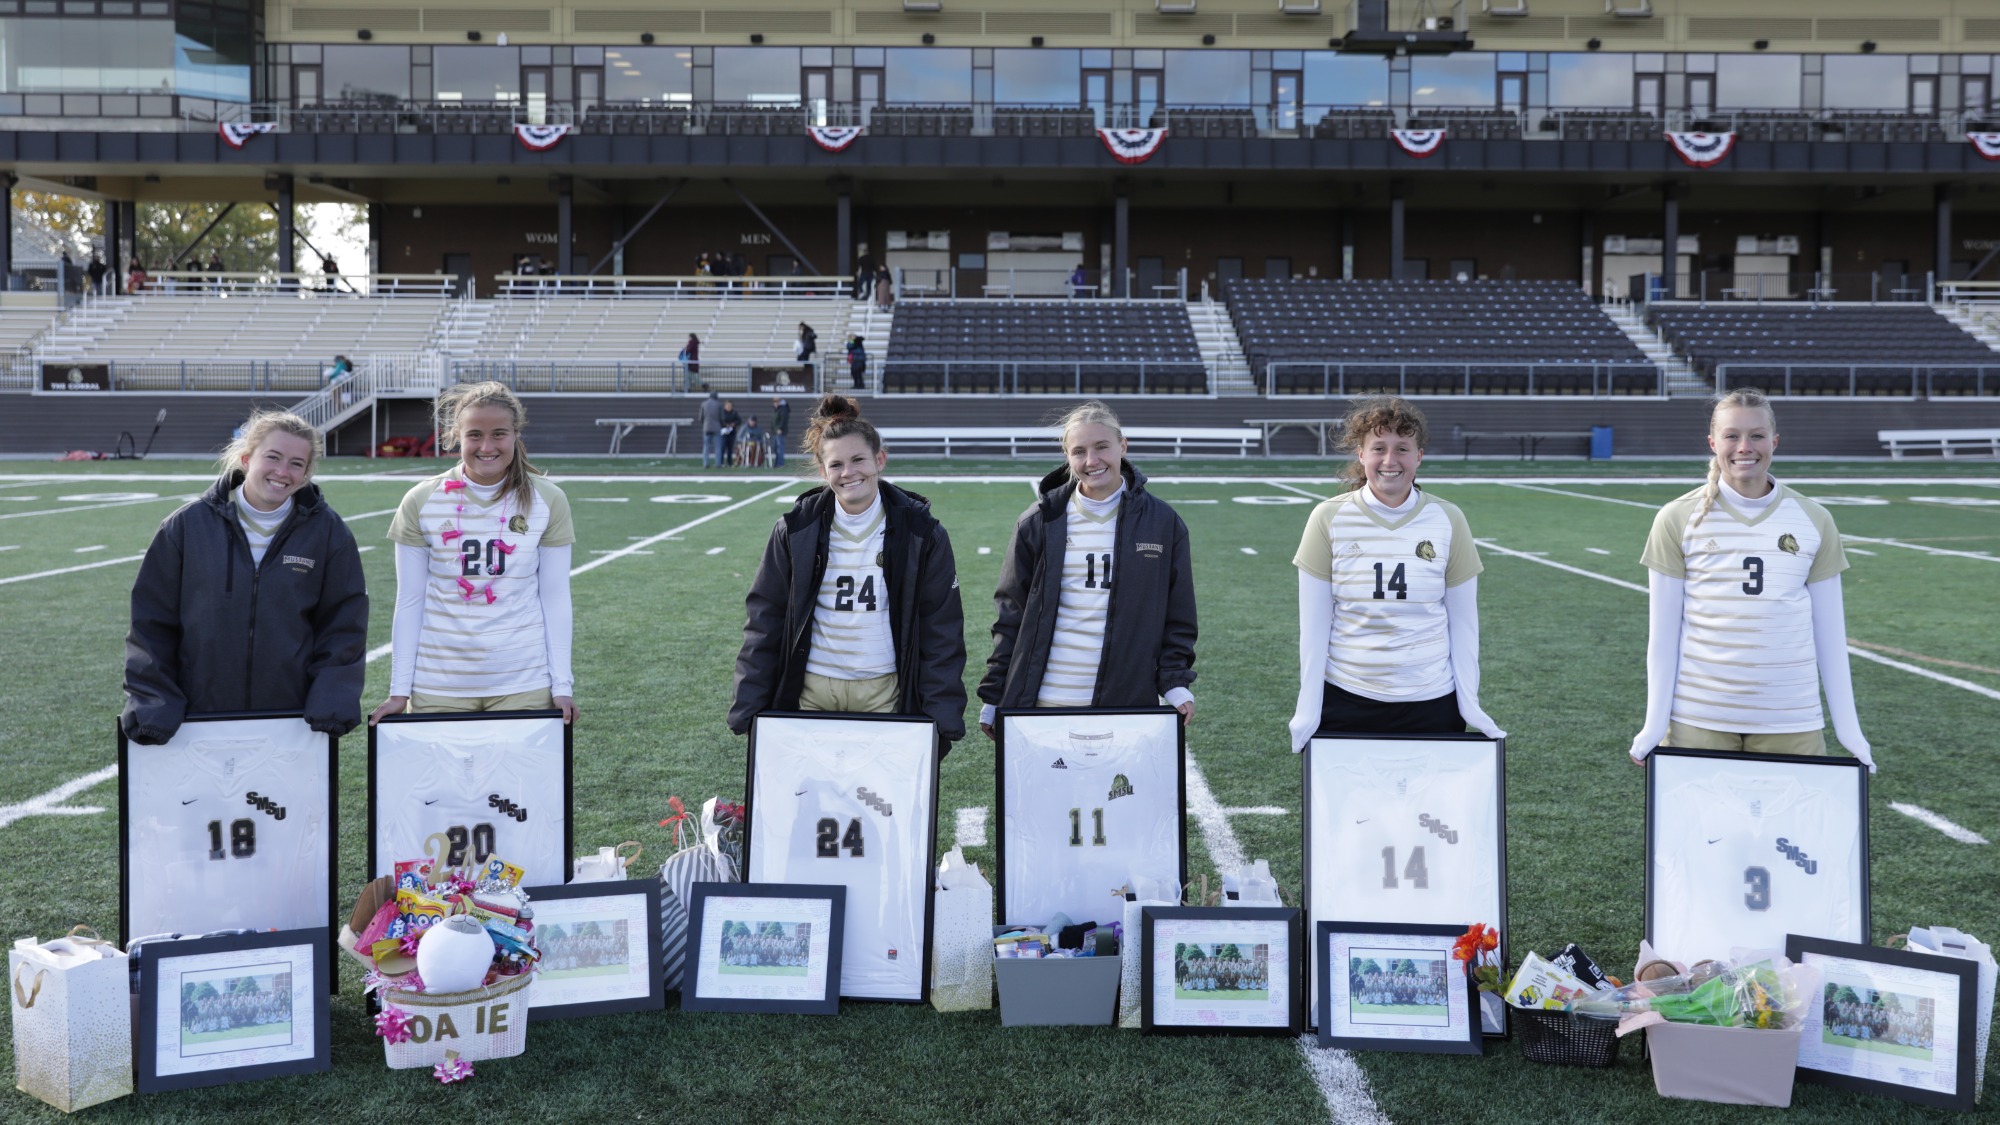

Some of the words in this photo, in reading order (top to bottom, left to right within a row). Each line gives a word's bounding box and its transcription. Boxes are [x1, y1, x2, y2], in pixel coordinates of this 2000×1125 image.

[525, 232, 577, 244] WOM
[741, 233, 771, 244] MEN
[50, 382, 66, 390] THE
[461, 538, 506, 576] 20
[1084, 552, 1112, 590] 11
[1742, 556, 1764, 596] 3
[834, 574, 877, 612] 24
[1372, 562, 1408, 600] 14
[245, 791, 287, 821] SMSU
[487, 793, 528, 823] SMSU
[856, 786, 893, 817] SMSU
[1107, 784, 1135, 802] SMSU
[207, 817, 257, 861] 18
[445, 822, 497, 868] 20
[816, 816, 865, 859] 24
[1068, 807, 1107, 847] 11
[1418, 813, 1459, 845] SMSU
[1381, 845, 1429, 889] 14
[1775, 837, 1818, 875] SMSU
[1743, 865, 1772, 912] 3
